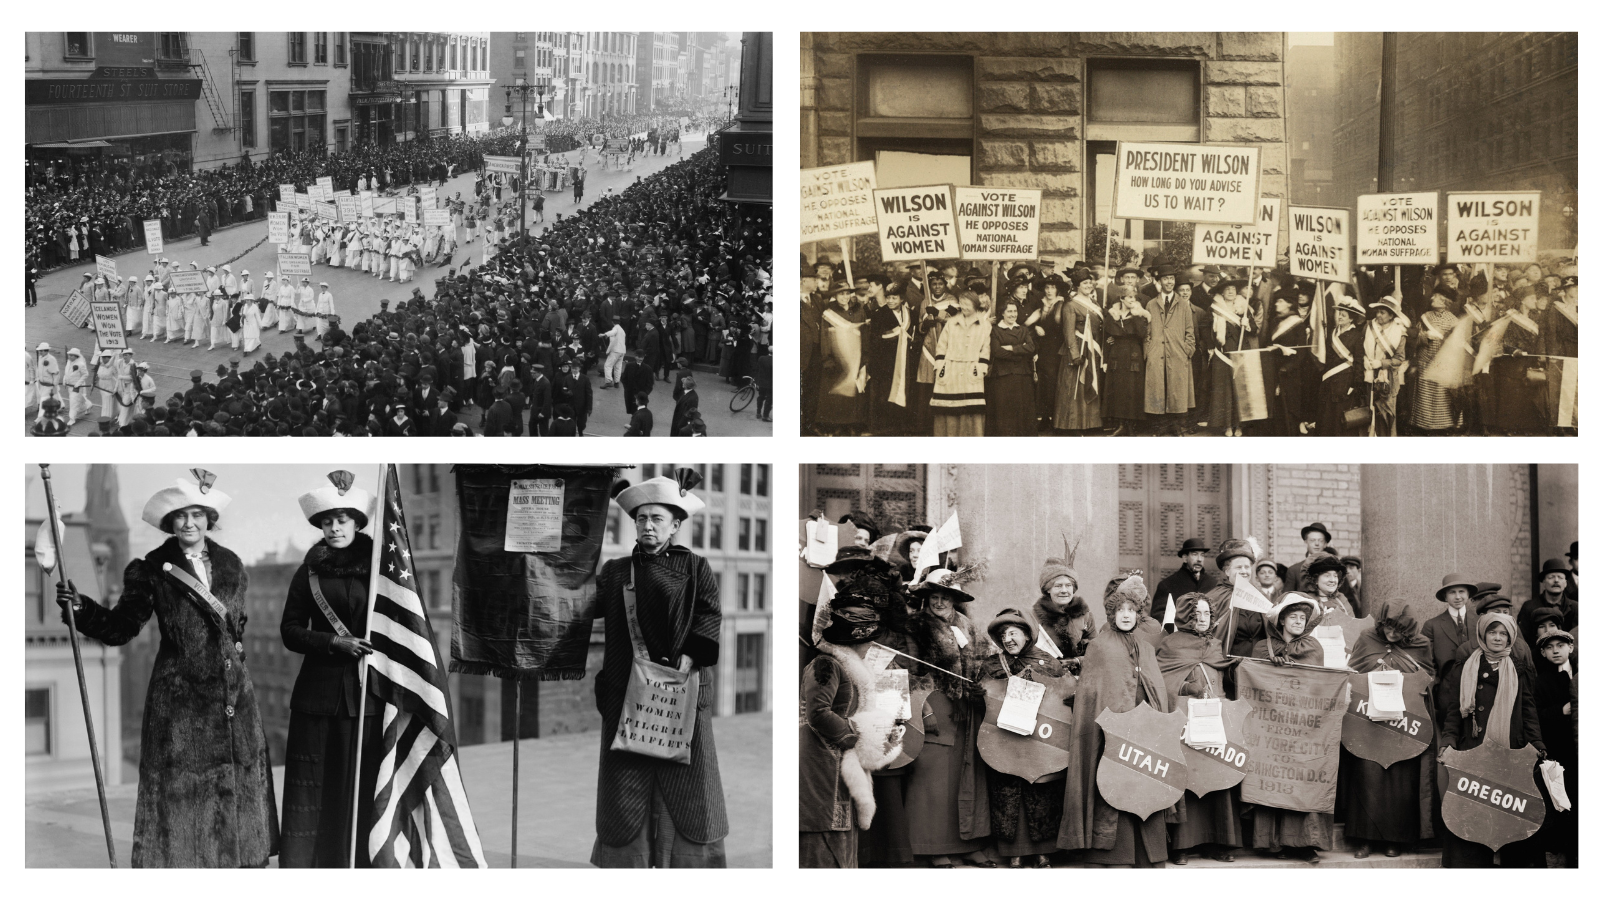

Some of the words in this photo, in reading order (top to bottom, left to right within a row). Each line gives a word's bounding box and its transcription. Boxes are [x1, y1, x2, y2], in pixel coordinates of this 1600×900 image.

[112, 34, 138, 44] WEARER
[103, 68, 147, 77] STEEL'S
[50, 84, 115, 99] FOURTEENTH
[138, 84, 158, 96] SUIT
[162, 84, 190, 96] STORE
[732, 144, 773, 156] SUIT
[1126, 150, 1197, 173] PRESIDENT
[1201, 154, 1250, 175] WILSON
[813, 169, 848, 180] VOTE
[800, 182, 833, 199] GAINST
[838, 177, 871, 194] WILSON
[1131, 176, 1150, 188] HOW
[1151, 177, 1172, 189] LONG
[1175, 178, 1187, 190] DO
[1189, 179, 1207, 191] YOU
[1209, 180, 1242, 193] ADVISE
[804, 202, 816, 211] HE
[820, 194, 867, 209] OPPOSES
[881, 193, 947, 214] WILSON
[981, 193, 1016, 202] VOTE
[1144, 194, 1160, 208] US
[1164, 195, 1178, 209] TO
[1184, 196, 1215, 212] WAIT
[1218, 198, 1225, 212] ?
[1382, 198, 1412, 206] VOTE
[818, 209, 860, 221] NATIONAL
[958, 203, 1000, 218] AGAINST
[1002, 203, 1036, 218] WILSON
[1363, 208, 1398, 221] AGAINST
[1401, 208, 1433, 221] WILSON
[1457, 200, 1532, 218] WILSON
[801, 223, 831, 235] WOMAN
[833, 216, 877, 230] SUFFRAGE
[909, 214, 920, 222] IS
[965, 220, 979, 230] HE
[982, 221, 1029, 231] OPPOSES
[1294, 214, 1342, 235] WILSON
[886, 223, 950, 239] AGAINST
[1368, 226, 1380, 234] HE
[1383, 225, 1427, 234] OPPOSES
[1456, 228, 1531, 242] AGAINST
[976, 234, 1018, 243] NATIONAL
[1202, 230, 1272, 246] AGAINST
[1378, 238, 1416, 246] NATIONAL
[891, 239, 945, 254] WOMEN
[989, 244, 1033, 254] SUFFRAGE
[1206, 245, 1262, 260] WOMEN
[1295, 242, 1343, 260] AGAINST
[1362, 248, 1388, 257] WOMAN
[1390, 248, 1432, 257] SUFFRAGE
[1461, 244, 1521, 256] WOMEN
[1298, 258, 1338, 276] WOMEN
[62, 293, 78, 314] NORWAY
[513, 496, 529, 504] MASS
[531, 496, 560, 505] MEETING
[193, 582, 212, 601] VOTES
[211, 600, 224, 614] FOR
[314, 590, 329, 611] VOTES
[327, 610, 338, 624] FOR
[646, 678, 686, 694] VOTES
[651, 694, 677, 705] FOR
[1275, 692, 1296, 707] FOR
[1300, 696, 1337, 711] WOMEN
[636, 702, 682, 720] WOMEN
[1252, 706, 1322, 728] PILGRIMAGE
[1356, 700, 1422, 736] KSAS
[621, 730, 691, 749] LEAFLETS
[1264, 736, 1297, 753] YORK
[1300, 740, 1330, 756] CITY
[1118, 744, 1170, 778] UTAH
[1248, 760, 1303, 781] SHINGTON
[1308, 769, 1330, 784] D.C.
[1260, 779, 1294, 794] 1913
[1457, 777, 1527, 813] OREGON
